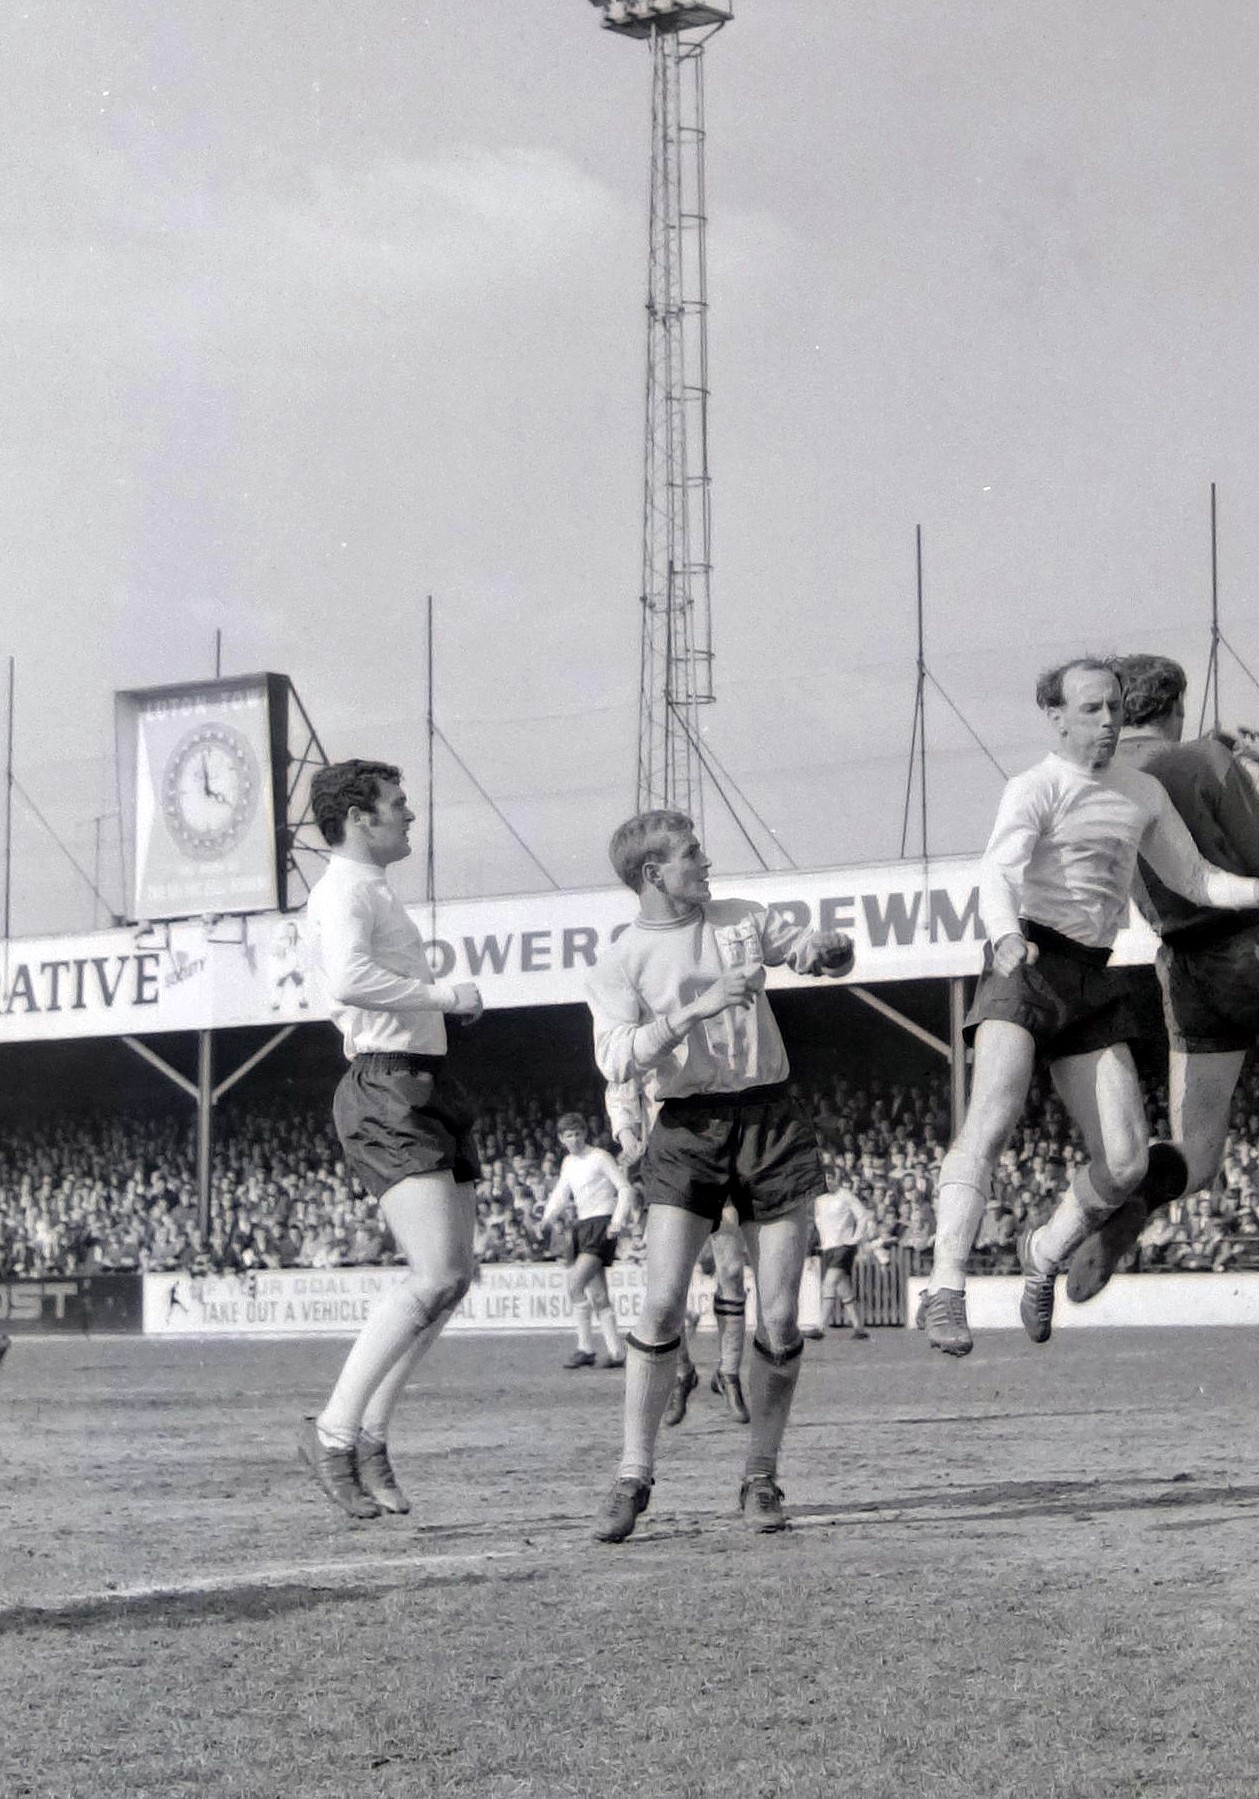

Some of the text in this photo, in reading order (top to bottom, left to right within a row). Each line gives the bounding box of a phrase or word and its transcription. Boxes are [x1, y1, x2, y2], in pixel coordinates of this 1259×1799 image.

[422, 922, 631, 979] OWER
[0, 953, 160, 1014] ATIVE
[0, 1282, 78, 1320] ST
[246, 1300, 278, 1323] OUT
[302, 1299, 370, 1322] VEHICLE
[485, 1295, 522, 1319] LIFE
